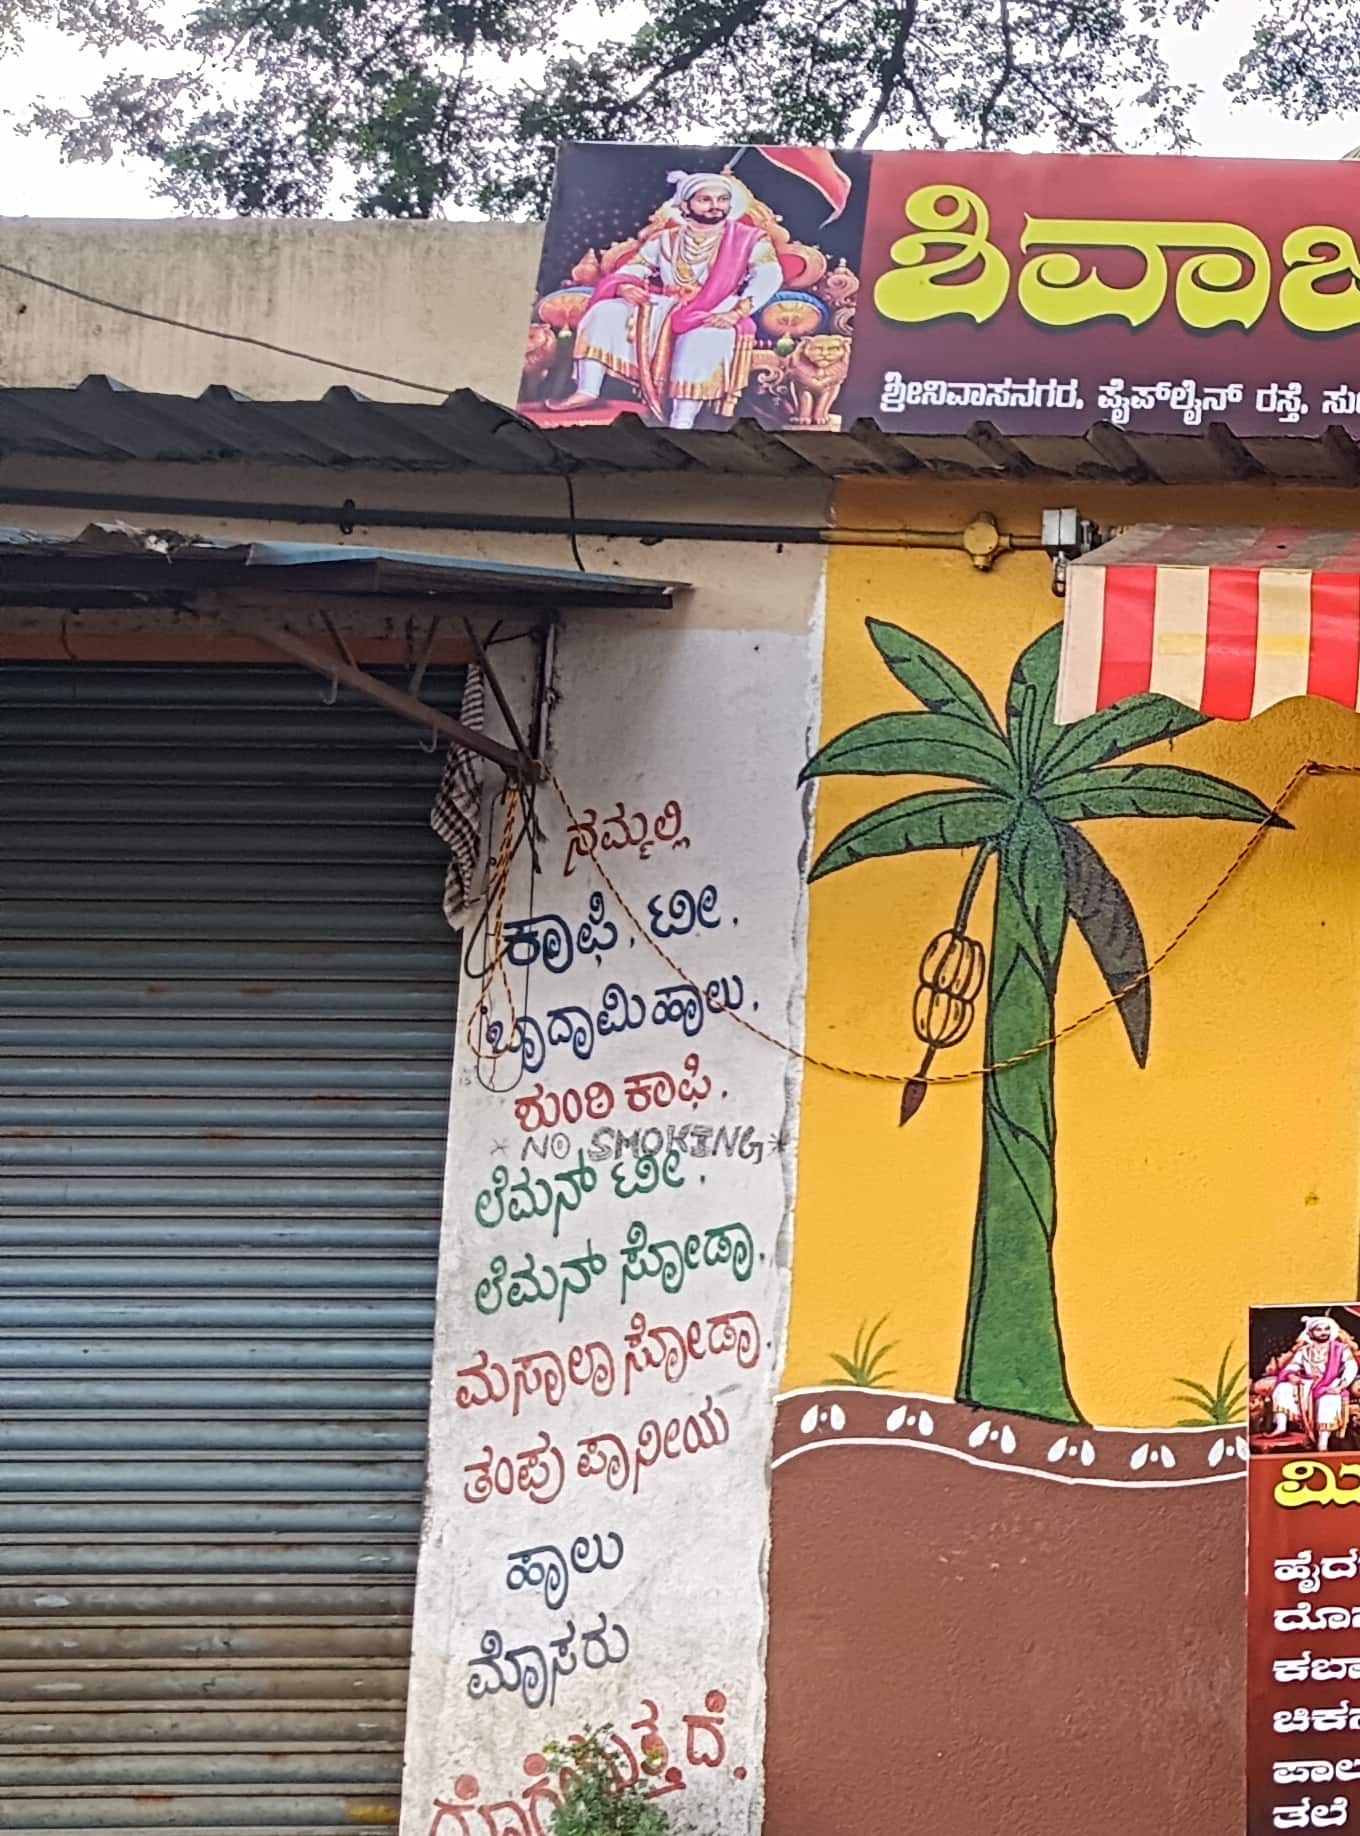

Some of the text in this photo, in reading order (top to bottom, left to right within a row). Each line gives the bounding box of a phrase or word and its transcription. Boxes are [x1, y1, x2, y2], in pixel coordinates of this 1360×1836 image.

[563, 799, 692, 877] ನಮ್ಮಲ್ಲಿ
[520, 1123, 765, 1165] NO SMOKING
[474, 1148, 598, 1239] ಲೆಮನ್
[474, 1238, 608, 1324] ಲೆಮನ್
[454, 1340, 615, 1417] ಮಸಾಲಾ
[463, 1393, 731, 1505] ತಂಪು ಪಾನೀಯ
[505, 1529, 625, 1611] ಹಾಲು
[466, 1611, 631, 1711] ಮೊಸರು
[1272, 1796, 1349, 1829] ತಲೆ
